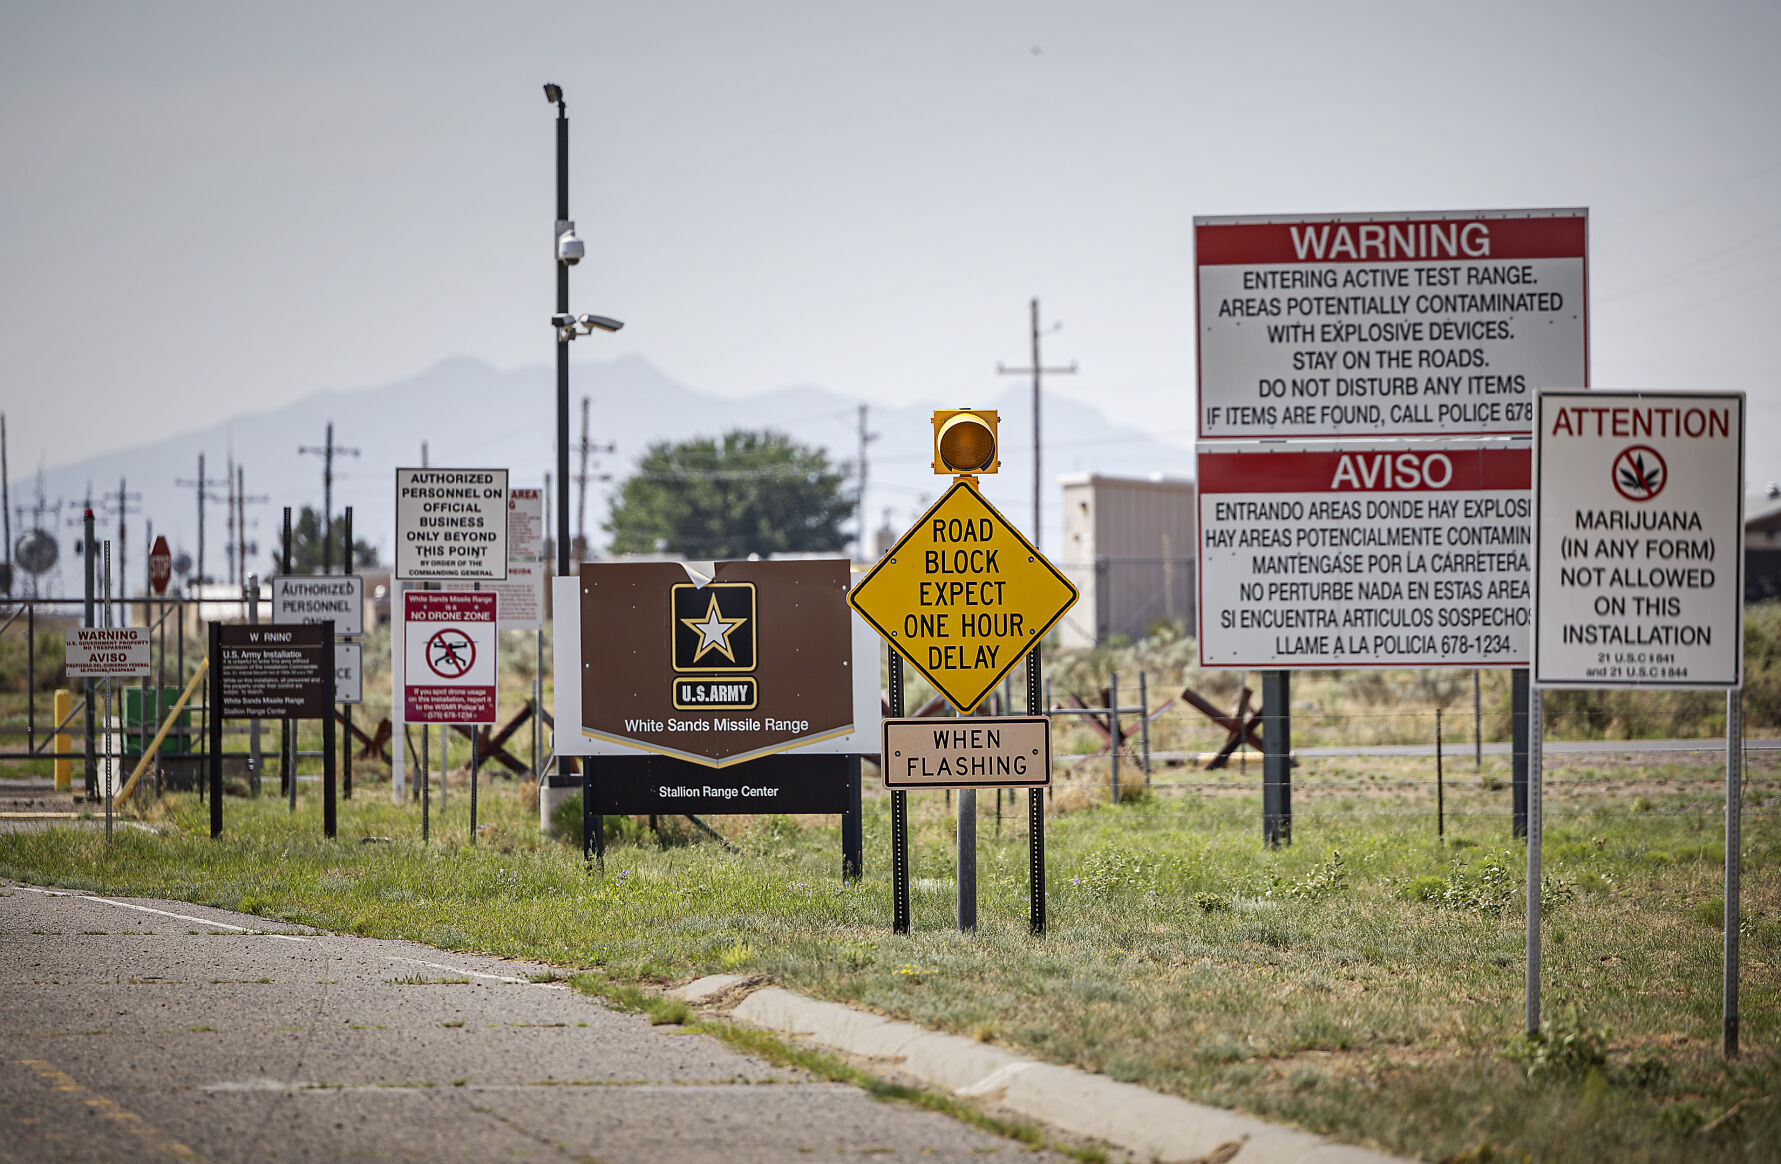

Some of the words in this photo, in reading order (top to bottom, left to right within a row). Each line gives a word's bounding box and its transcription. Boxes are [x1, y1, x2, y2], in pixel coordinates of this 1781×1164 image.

[1290, 223, 1490, 259] WARNING
[1244, 269, 1337, 290] ENTERING
[1343, 268, 1409, 288] ACTIVE
[1414, 267, 1461, 286] TEST
[1467, 266, 1537, 285] RANGE.
[1219, 298, 1281, 317] AREAS
[1288, 296, 1410, 316] POTENTIALLY
[1416, 292, 1563, 313] CONTAMINATED
[1267, 324, 1314, 343] WITH
[1321, 322, 1423, 342] EXPLOSIVE
[1430, 320, 1514, 340] DEVICES.
[1293, 351, 1337, 370] STAY
[1343, 351, 1370, 369] ON
[1376, 350, 1412, 368] THE
[1419, 348, 1489, 368] ROADS.
[1259, 379, 1286, 398] DO
[1292, 378, 1330, 397] NOT
[1337, 377, 1418, 396] DISTURB
[1424, 376, 1462, 395] ANY
[1468, 375, 1525, 394] ITEMS
[1207, 407, 1221, 425] IF
[1226, 406, 1277, 425] ITEMS
[1282, 406, 1316, 424] ARE
[1321, 405, 1385, 427] FOUND,
[1390, 404, 1434, 423] CALL
[1439, 403, 1501, 422] POLICE
[1553, 408, 1729, 438] ATTENTION
[411, 474, 493, 484] AUTHORIZED
[1331, 454, 1452, 489] AVISO
[402, 488, 480, 498] PERSONNEL
[484, 489, 502, 498] ON
[423, 503, 481, 512] OFFICIAL
[1216, 501, 1303, 521] ENTRANDO
[1308, 501, 1361, 520] AREAS
[1367, 500, 1423, 519] DONDE
[1428, 500, 1459, 518] HAY
[420, 517, 483, 527] BUSINESS
[933, 519, 993, 542] ROAD
[1576, 510, 1702, 531] MARIJUANA
[407, 531, 439, 541] ONLY
[444, 532, 496, 541] BEYOND
[1206, 530, 1236, 547] HAY
[1239, 528, 1292, 547] AREAS
[1297, 527, 1442, 547] POTENCIALMENTE
[416, 546, 444, 557] THIS
[449, 546, 488, 556] POINT
[1561, 537, 1588, 559] (IN
[1595, 539, 1639, 558] ANY
[1646, 538, 1715, 562] FORM)
[926, 550, 999, 574] BLOCK
[1369, 554, 1402, 573] POR
[1407, 554, 1427, 573] LA
[1561, 567, 1605, 587] NOT
[1610, 568, 1715, 588] ALLOWED
[281, 581, 354, 596] AUTHORIZED
[920, 581, 1006, 606] EXPECT
[1241, 583, 1264, 601] NO
[1269, 582, 1353, 601] PERTURBE
[1359, 582, 1403, 600] NADA
[1408, 581, 1428, 600] EN
[1434, 580, 1483, 600] ESTAS
[283, 600, 351, 613] PERSONNEL
[411, 612, 425, 620] NO
[428, 612, 461, 620] DRONE
[464, 612, 490, 620] ZONE
[1594, 596, 1625, 616] ON
[1633, 597, 1680, 616] THIS
[905, 614, 949, 638] ONE
[962, 613, 1023, 637] HOUR
[1221, 610, 1235, 628] SI
[1241, 609, 1338, 628] ENCUENTRA
[1342, 608, 1433, 627] ARTICULOS
[78, 631, 138, 640] WARNING
[1277, 636, 1329, 655] LLAME
[1333, 636, 1345, 654] A
[1349, 636, 1370, 654] LA
[1374, 635, 1437, 654] POLICIA
[1564, 625, 1711, 645] INSTALLATION
[89, 653, 127, 662] AVISO
[223, 650, 239, 659] U.S.
[241, 651, 261, 660] Army
[929, 645, 1000, 670] DELAY
[1599, 653, 1610, 663] 21
[1586, 667, 1607, 677] and
[1611, 667, 1621, 677] 21
[625, 719, 663, 731] White
[668, 719, 709, 731] Sands
[714, 719, 760, 731] Missile
[765, 718, 808, 733] Range
[934, 730, 1000, 749] WHEN
[908, 756, 1026, 776] FLASHING
[660, 786, 700, 797] Stallion
[703, 786, 738, 799] Range
[741, 786, 779, 796] Center
